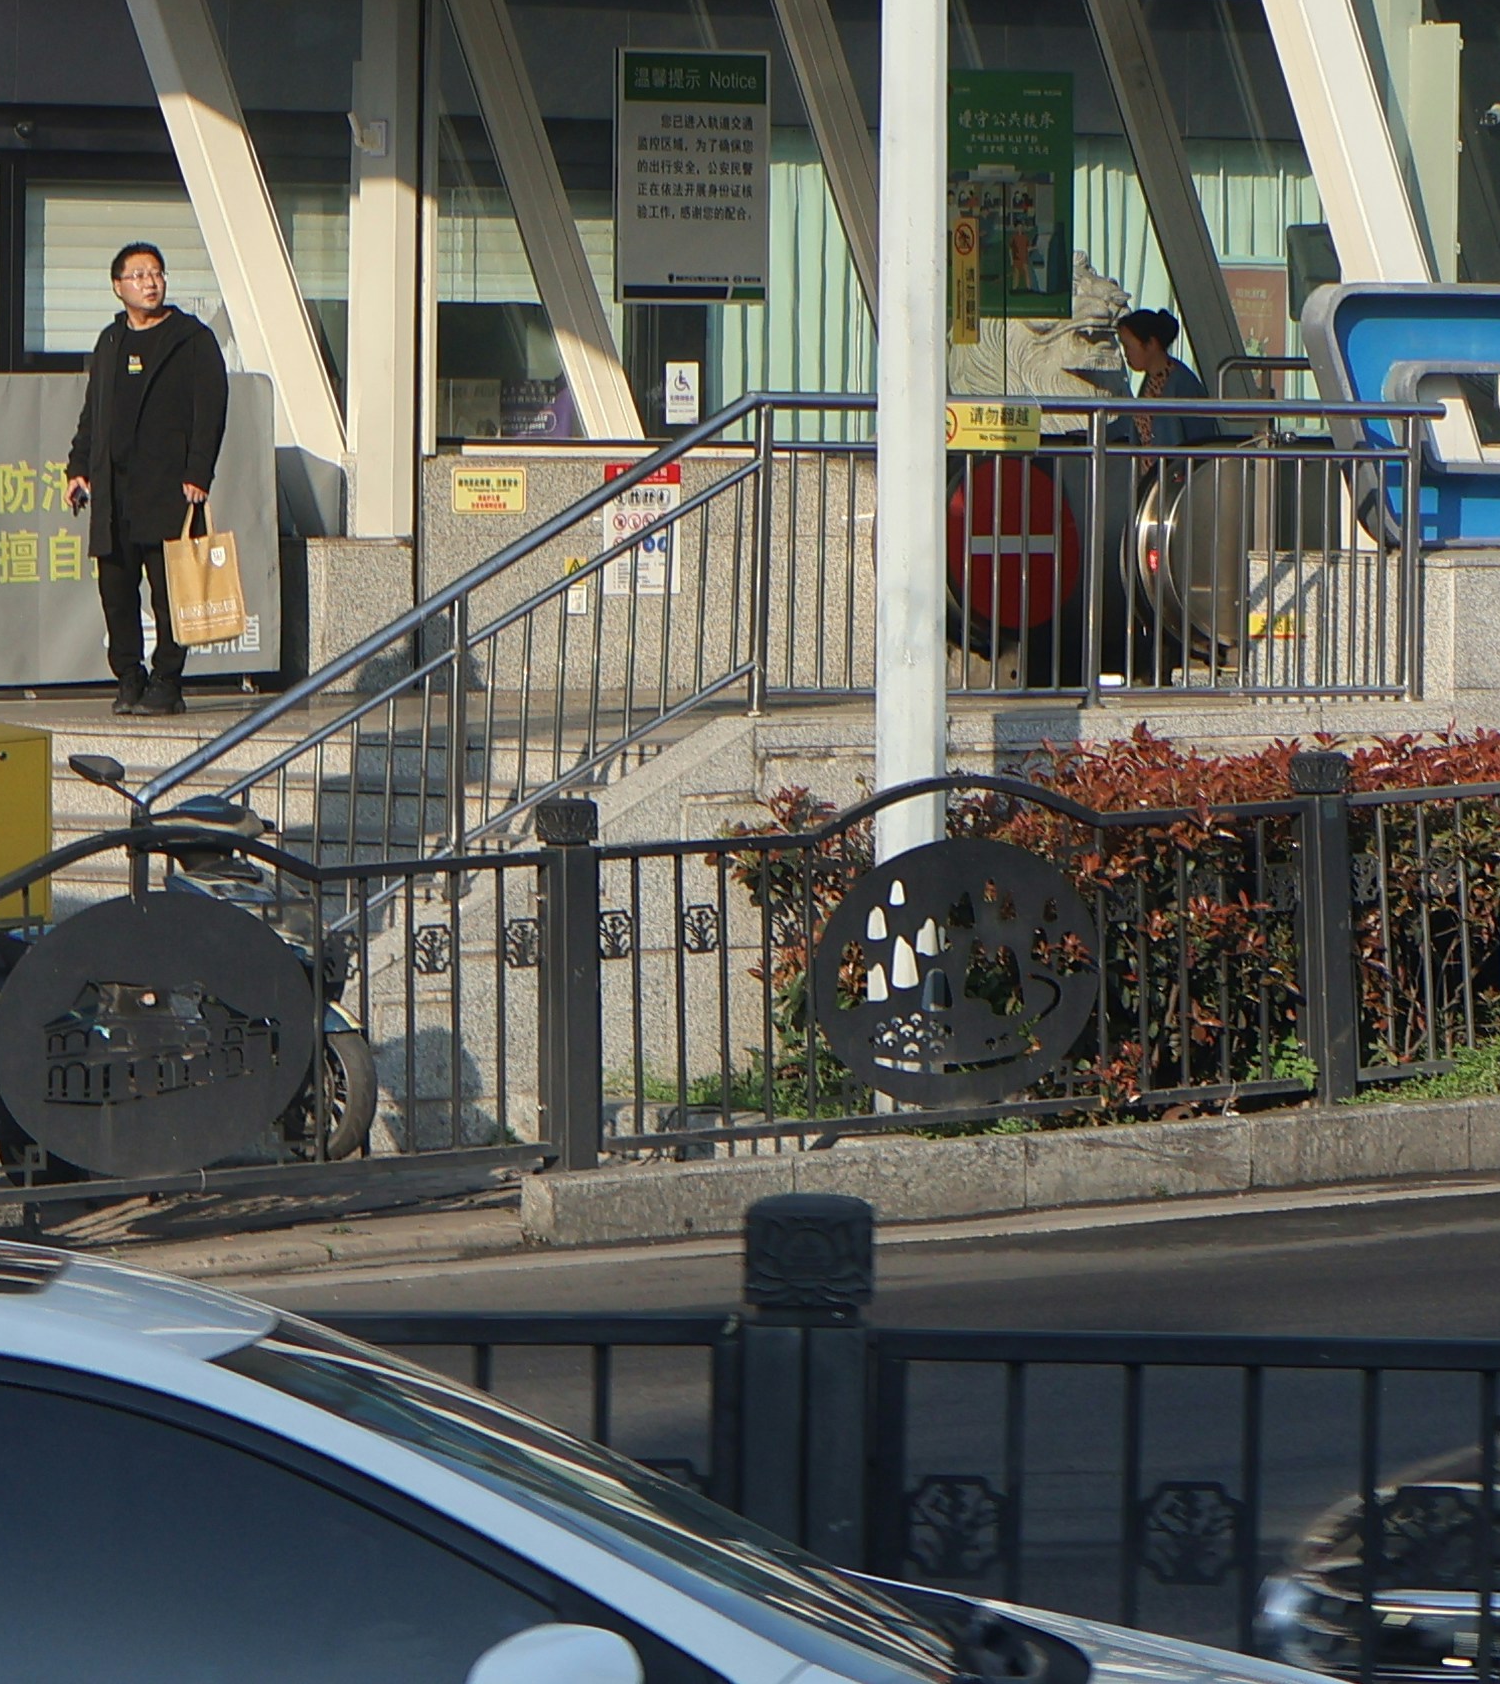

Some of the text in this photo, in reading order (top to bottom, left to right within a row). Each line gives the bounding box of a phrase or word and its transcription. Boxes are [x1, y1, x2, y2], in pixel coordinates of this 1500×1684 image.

[634, 67, 757, 90] 温馨提示 Notice
[970, 406, 1029, 426] 请勿翻越
